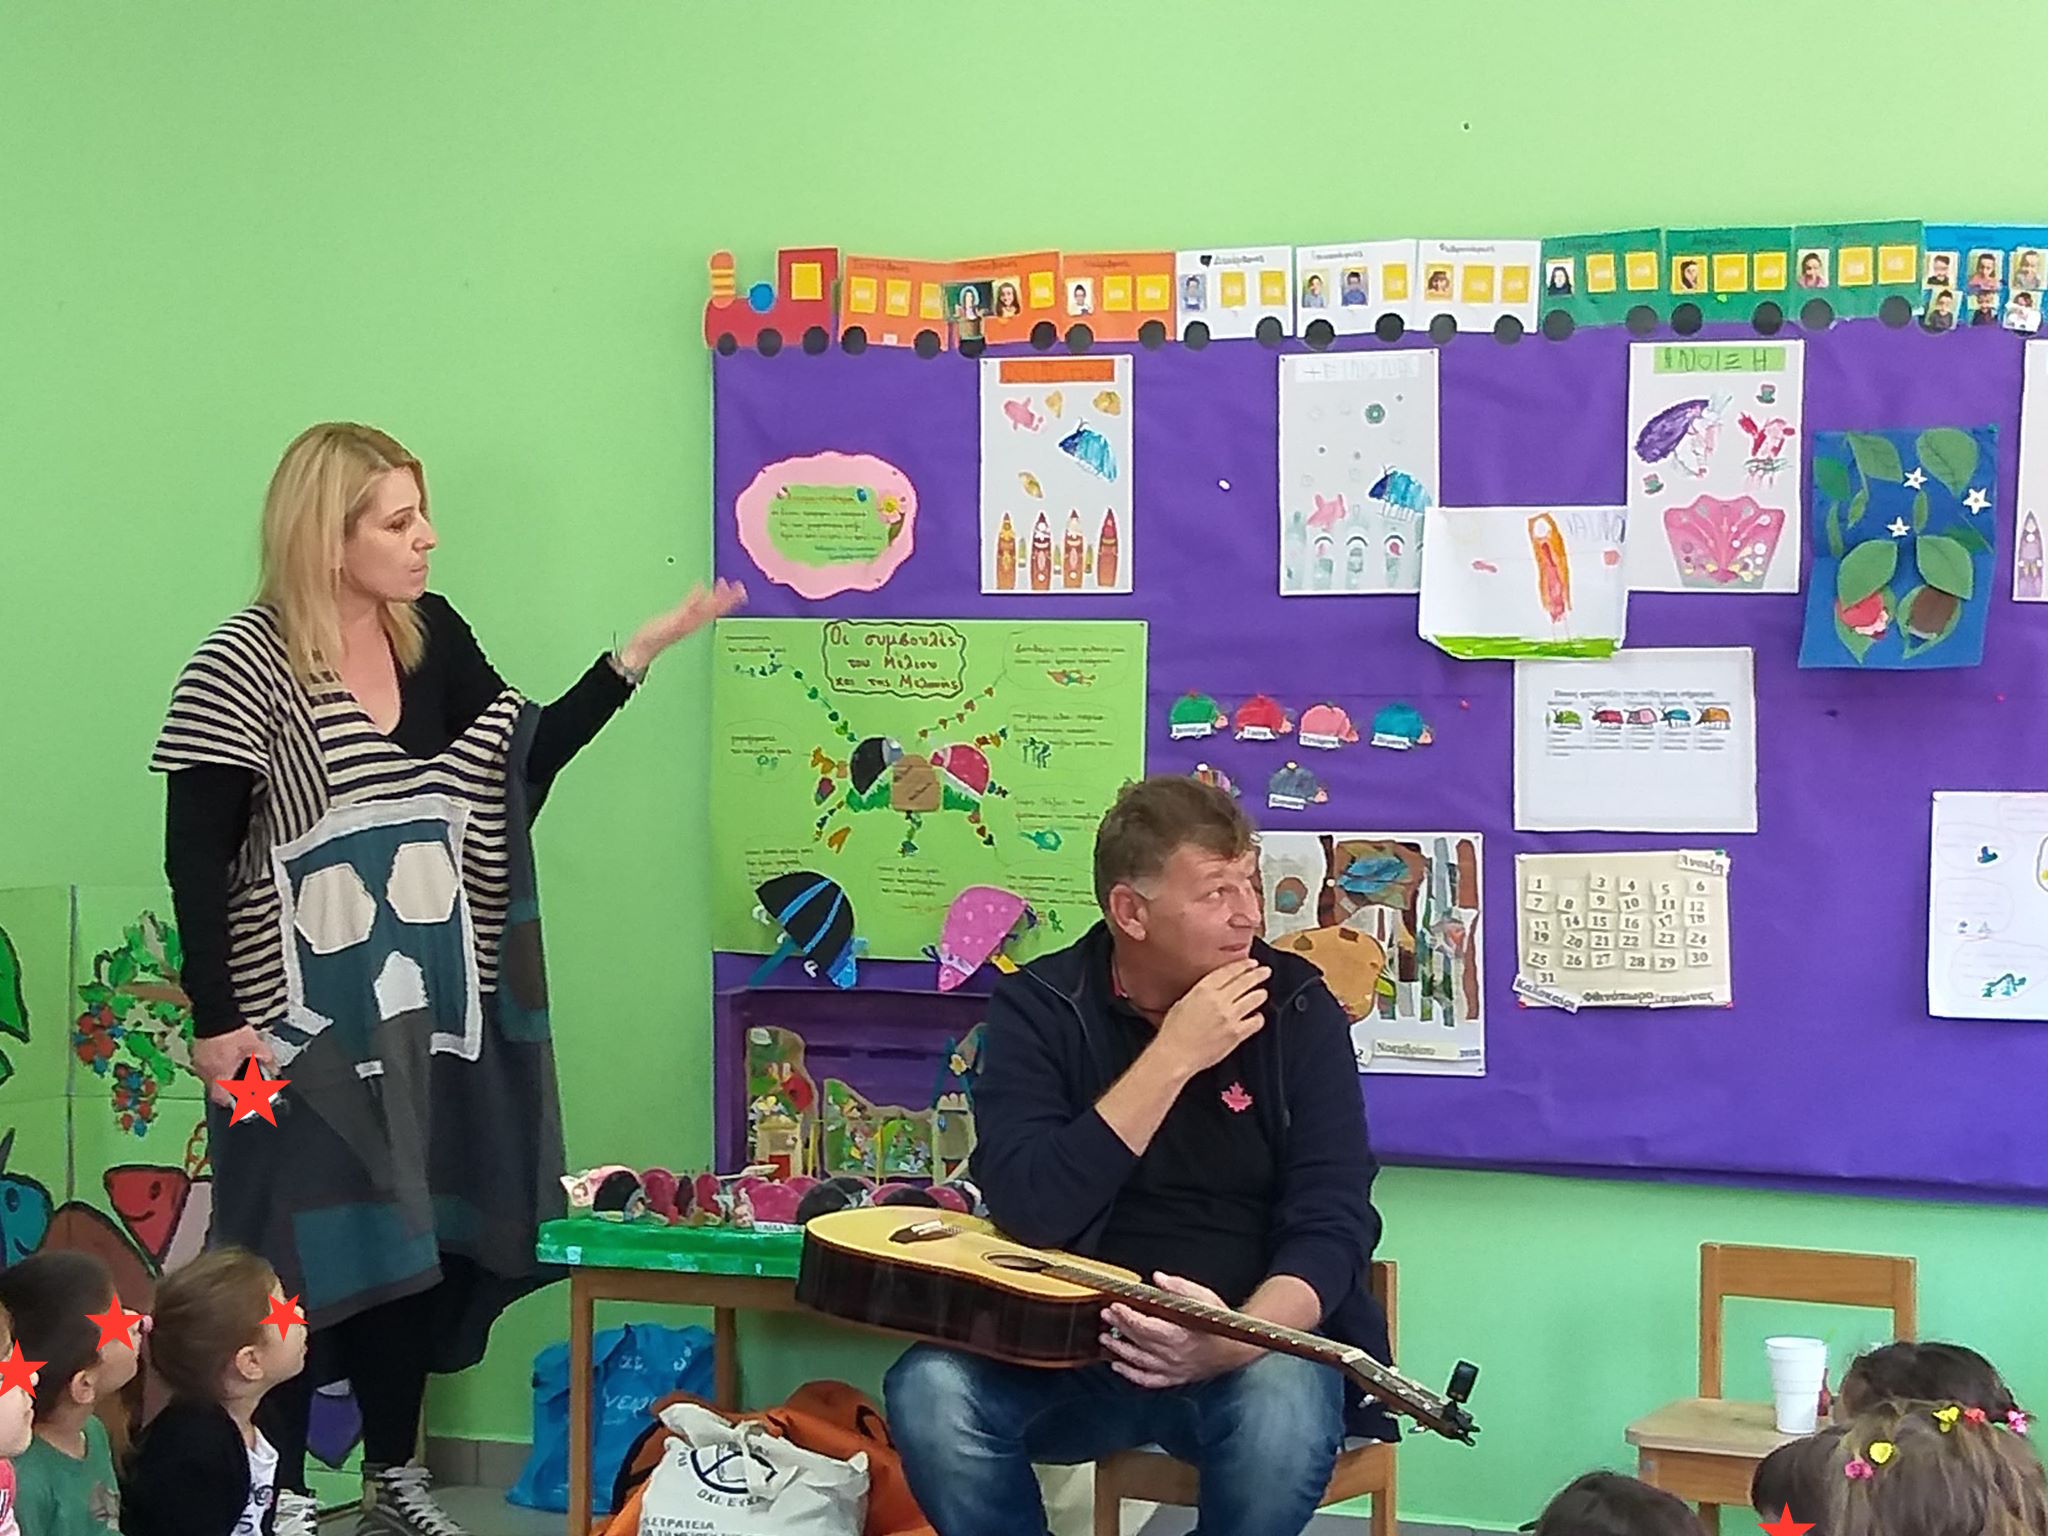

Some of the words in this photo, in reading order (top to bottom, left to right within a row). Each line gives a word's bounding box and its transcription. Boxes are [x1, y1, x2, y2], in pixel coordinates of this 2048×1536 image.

[1536, 879, 1542, 889] 1
[1597, 877, 1606, 888] 3
[1628, 880, 1636, 891] 4
[1662, 884, 1670, 895] 5
[1696, 881, 1705, 891] 6
[1534, 898, 1543, 908] 7
[1564, 899, 1574, 909] 8
[1596, 895, 1605, 906] 9
[1624, 898, 1640, 909] 10
[1661, 899, 1675, 910] 11
[1690, 901, 1704, 912] 12
[1565, 916, 1580, 927] 14
[1592, 916, 1607, 927] 15
[1625, 918, 1639, 929] 16
[1658, 914, 1673, 928] 17
[1534, 931, 1549, 942] 19
[1566, 935, 1583, 948] 20
[1594, 935, 1609, 946] 21
[1622, 935, 1639, 947] 22
[1658, 932, 1675, 944] 23
[1690, 932, 1707, 945] 24
[1531, 952, 1547, 965] 25
[1566, 954, 1582, 966] 26
[1596, 953, 1611, 965] 27
[1629, 956, 1645, 967] 28
[1659, 957, 1676, 968] 29
[1692, 952, 1708, 963] 30
[1540, 973, 1554, 983] 31
